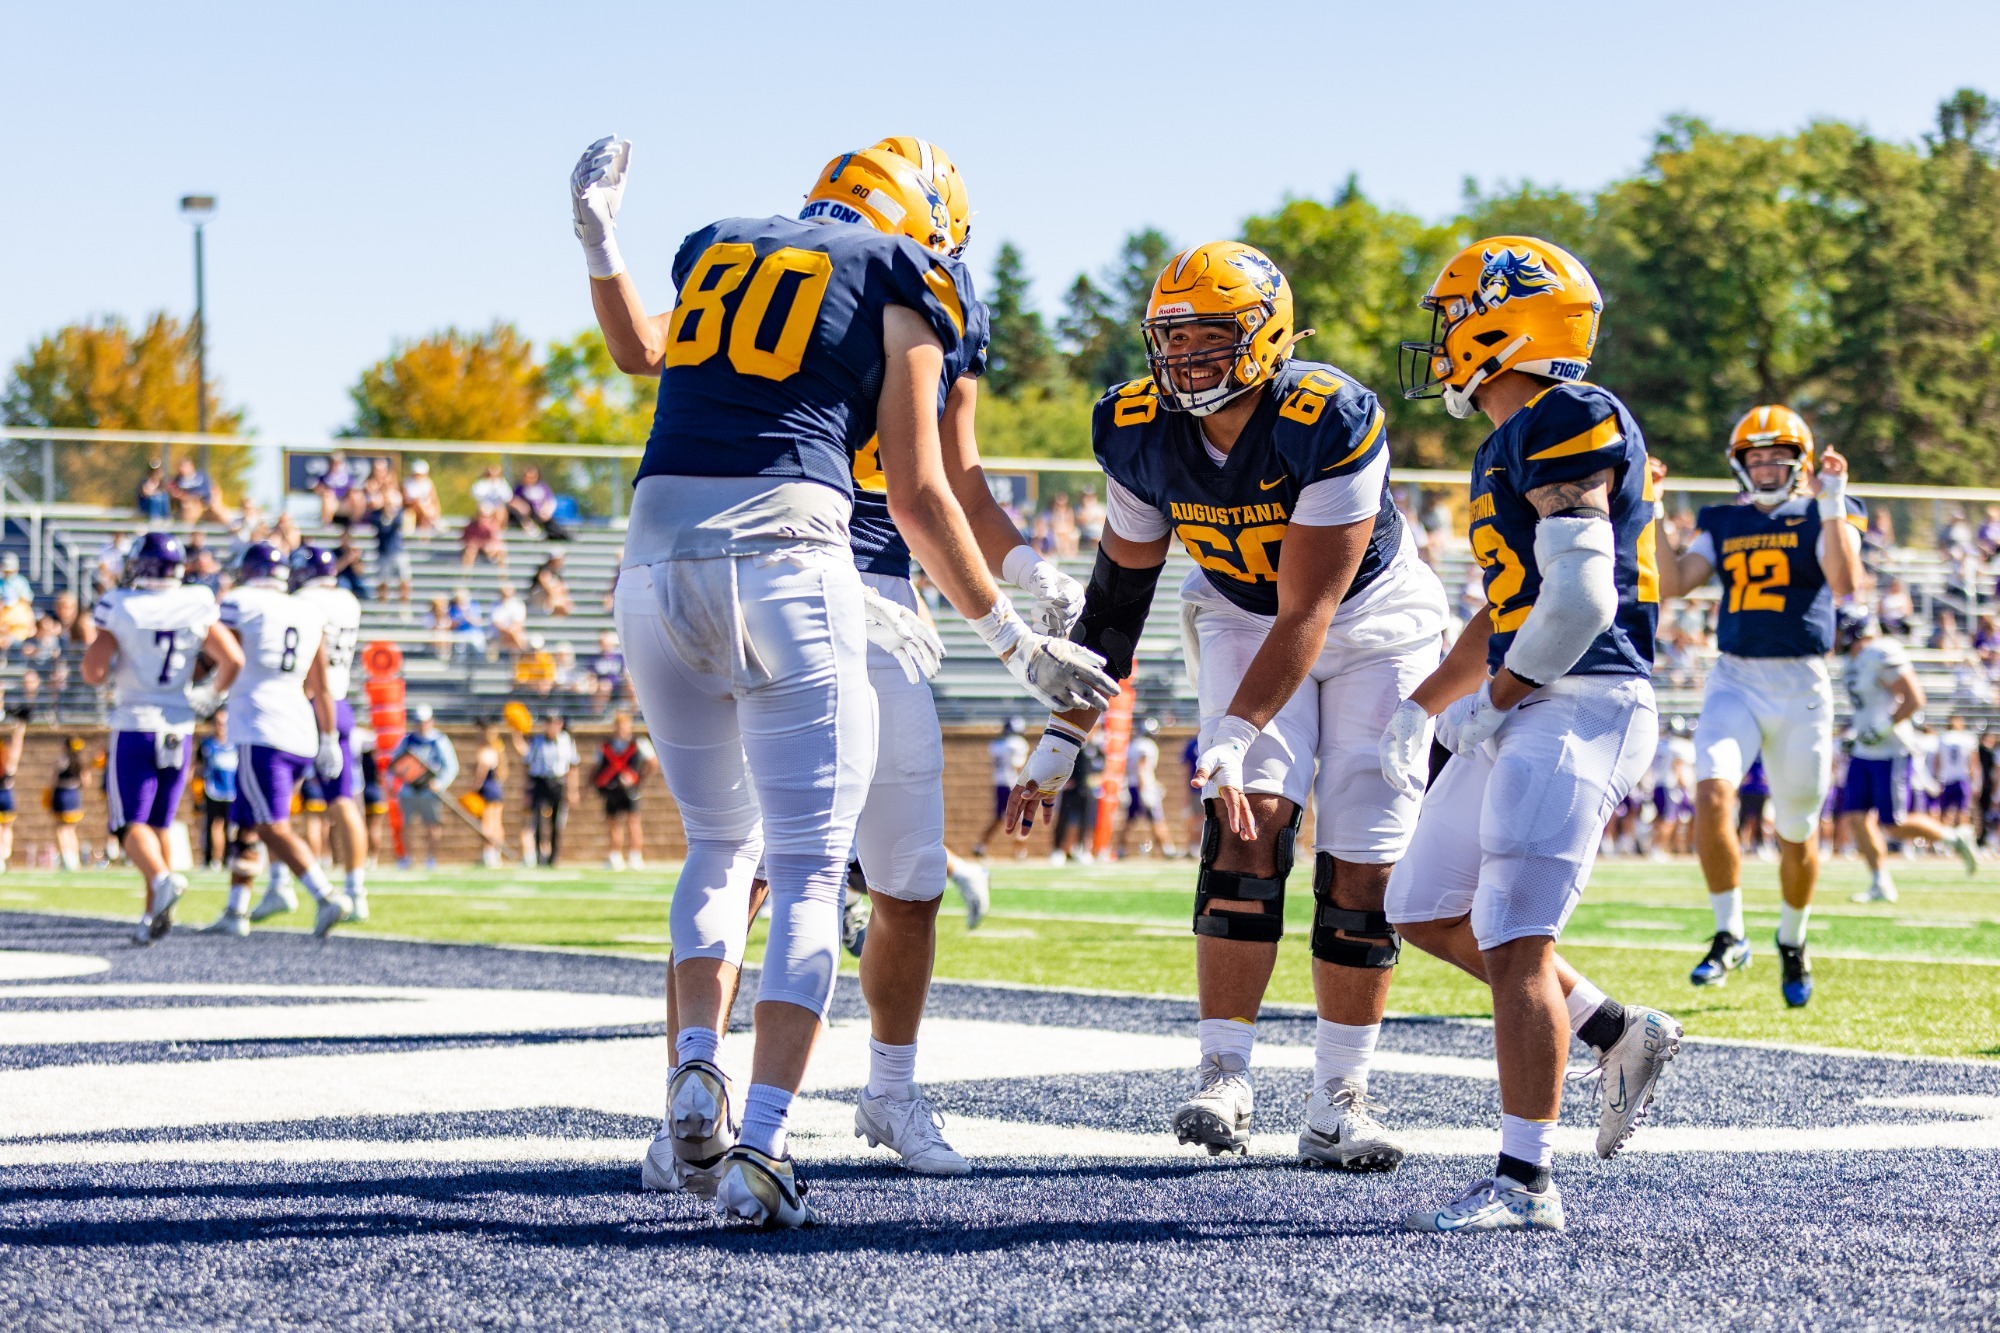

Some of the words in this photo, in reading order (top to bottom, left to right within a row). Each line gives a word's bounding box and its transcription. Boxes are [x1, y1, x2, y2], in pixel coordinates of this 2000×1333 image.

[799, 201, 830, 220] GHT
[829, 204, 861, 224] ON!
[852, 184, 870, 199] 80
[665, 243, 833, 382] 80
[1279, 370, 1345, 425] 60
[1170, 502, 1287, 525] AUGUSTANA
[1722, 532, 1799, 554] AUGUSTANA
[1723, 548, 1790, 614] 12
[154, 630, 176, 685] 7
[281, 626, 299, 673] 8
